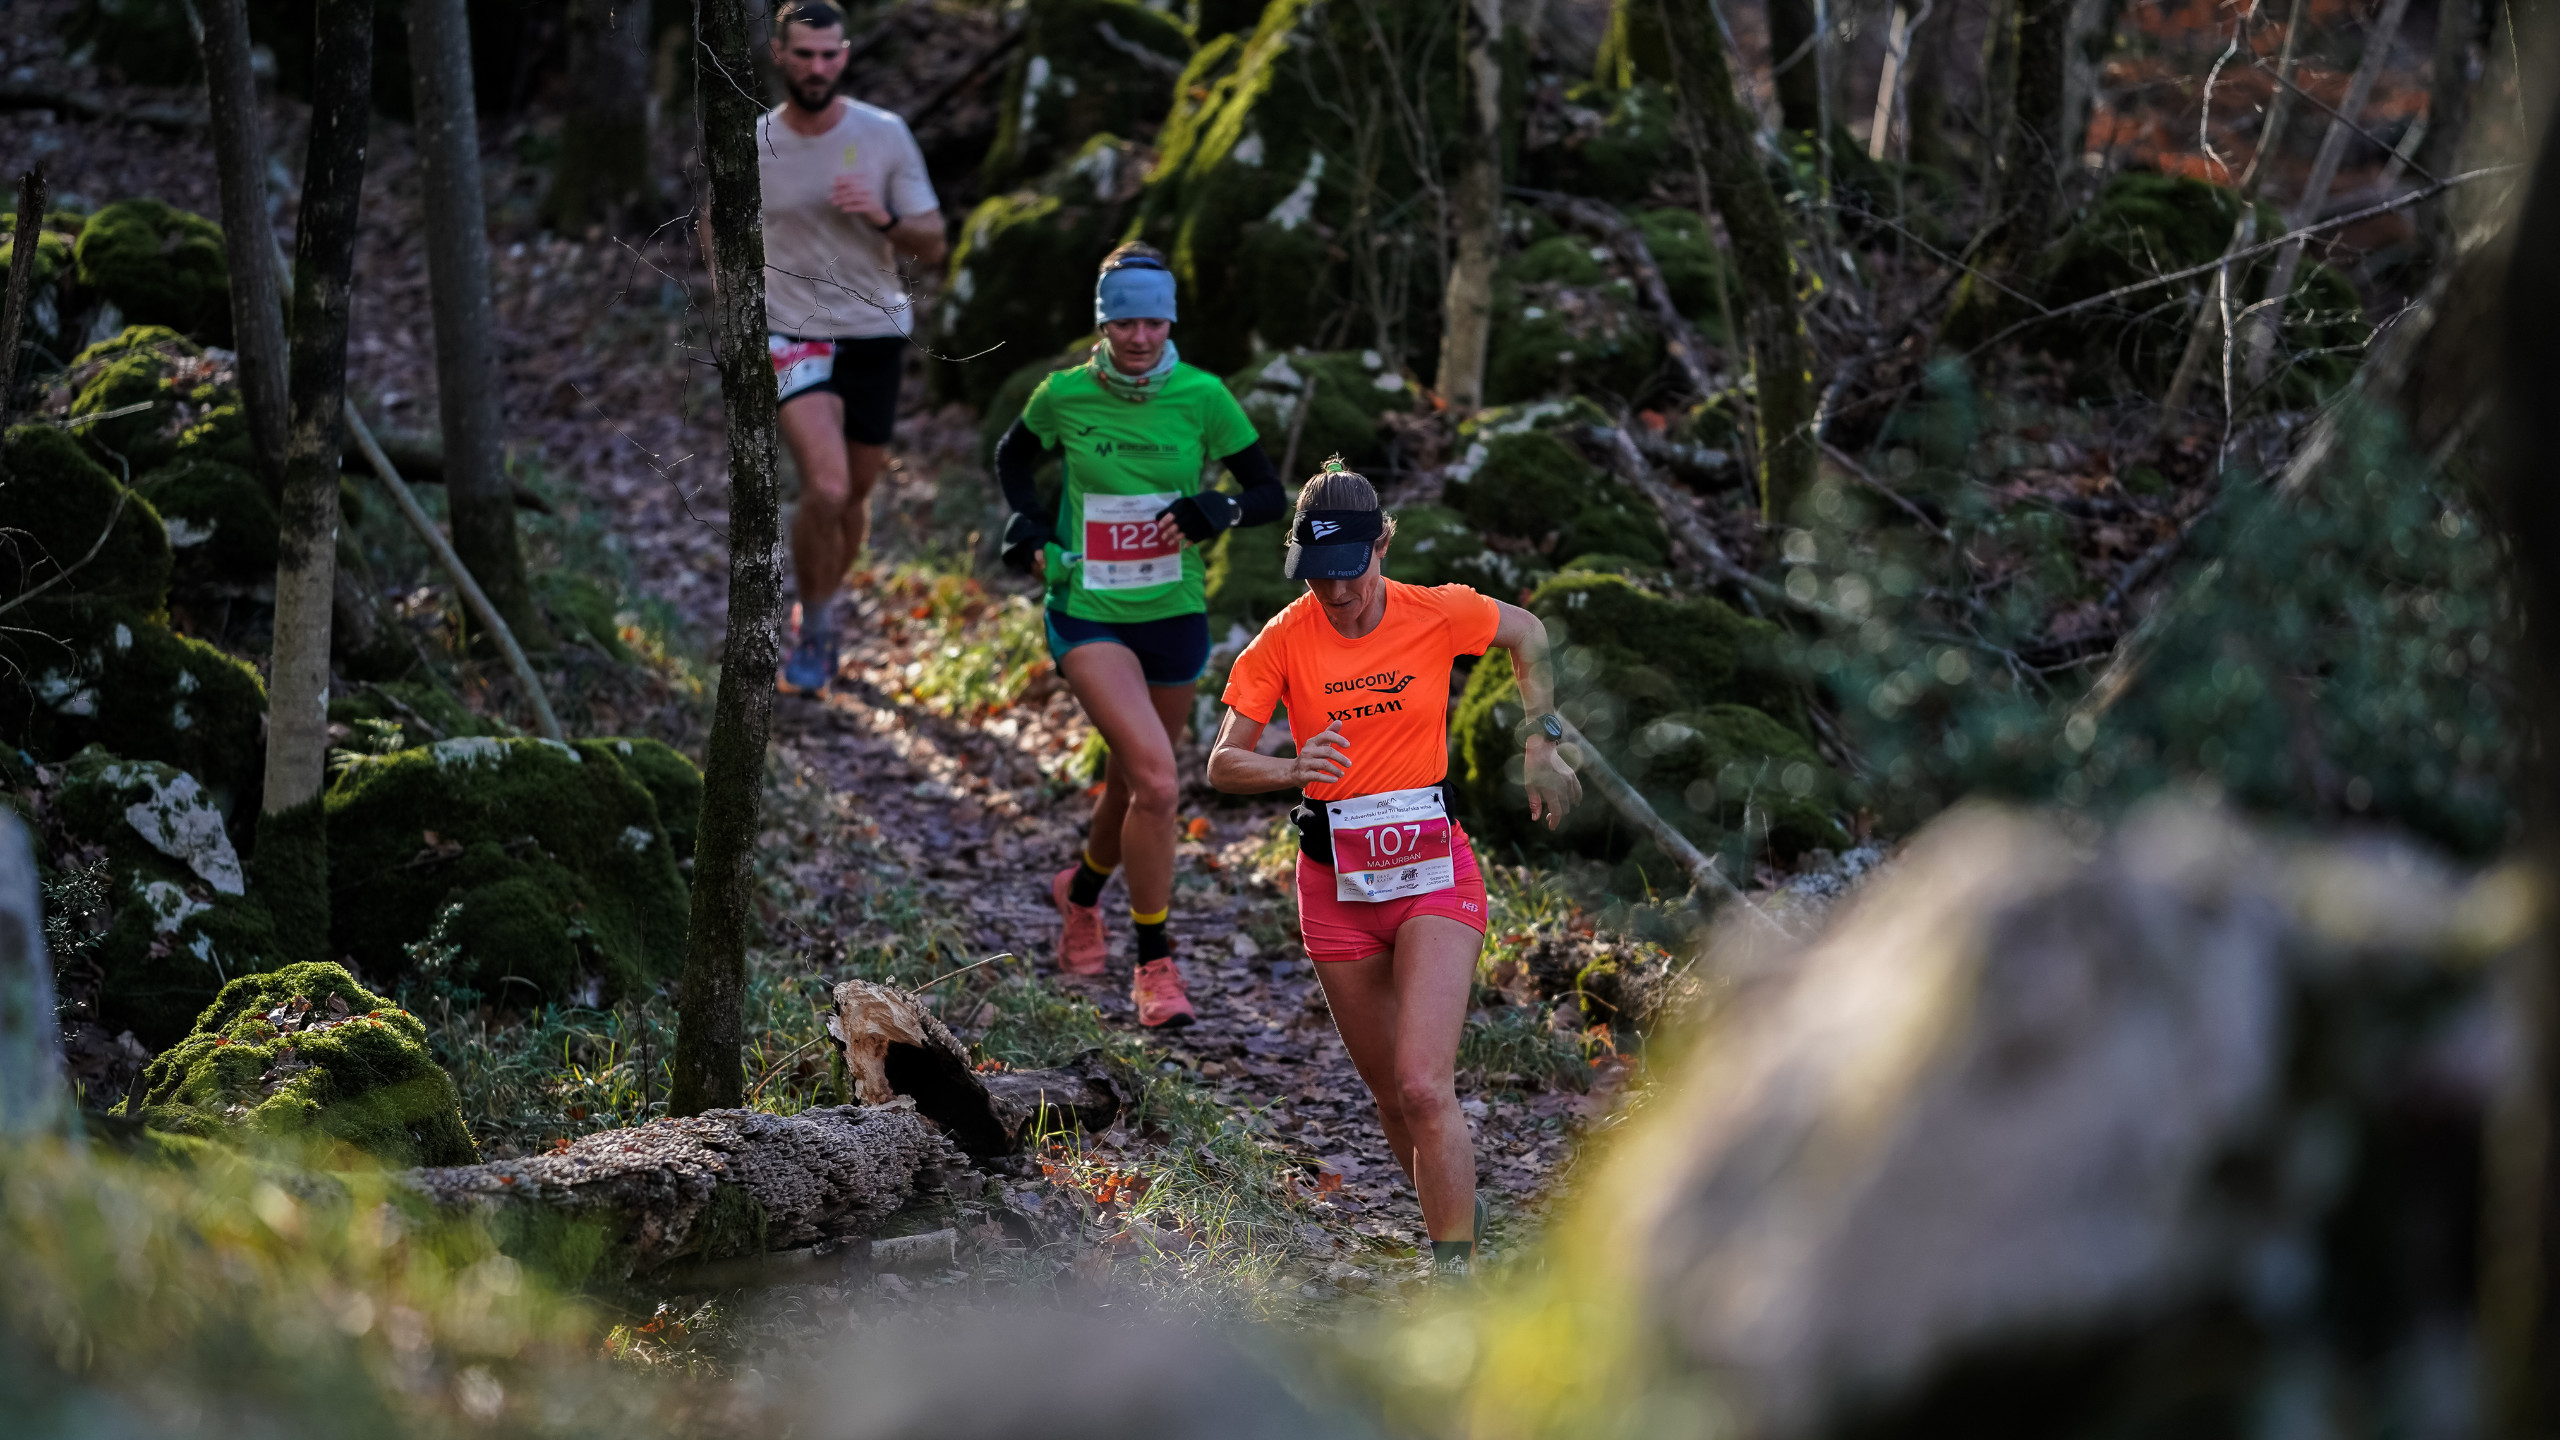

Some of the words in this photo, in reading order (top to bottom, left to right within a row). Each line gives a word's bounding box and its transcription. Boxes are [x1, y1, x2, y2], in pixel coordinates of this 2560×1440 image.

[1109, 523, 1158, 550] 122
[1324, 671, 1396, 694] saucony
[1353, 700, 1402, 718] TEAM
[1364, 824, 1421, 857] 107
[1367, 859, 1390, 868] MAJA
[1391, 853, 1421, 865] URBAN
